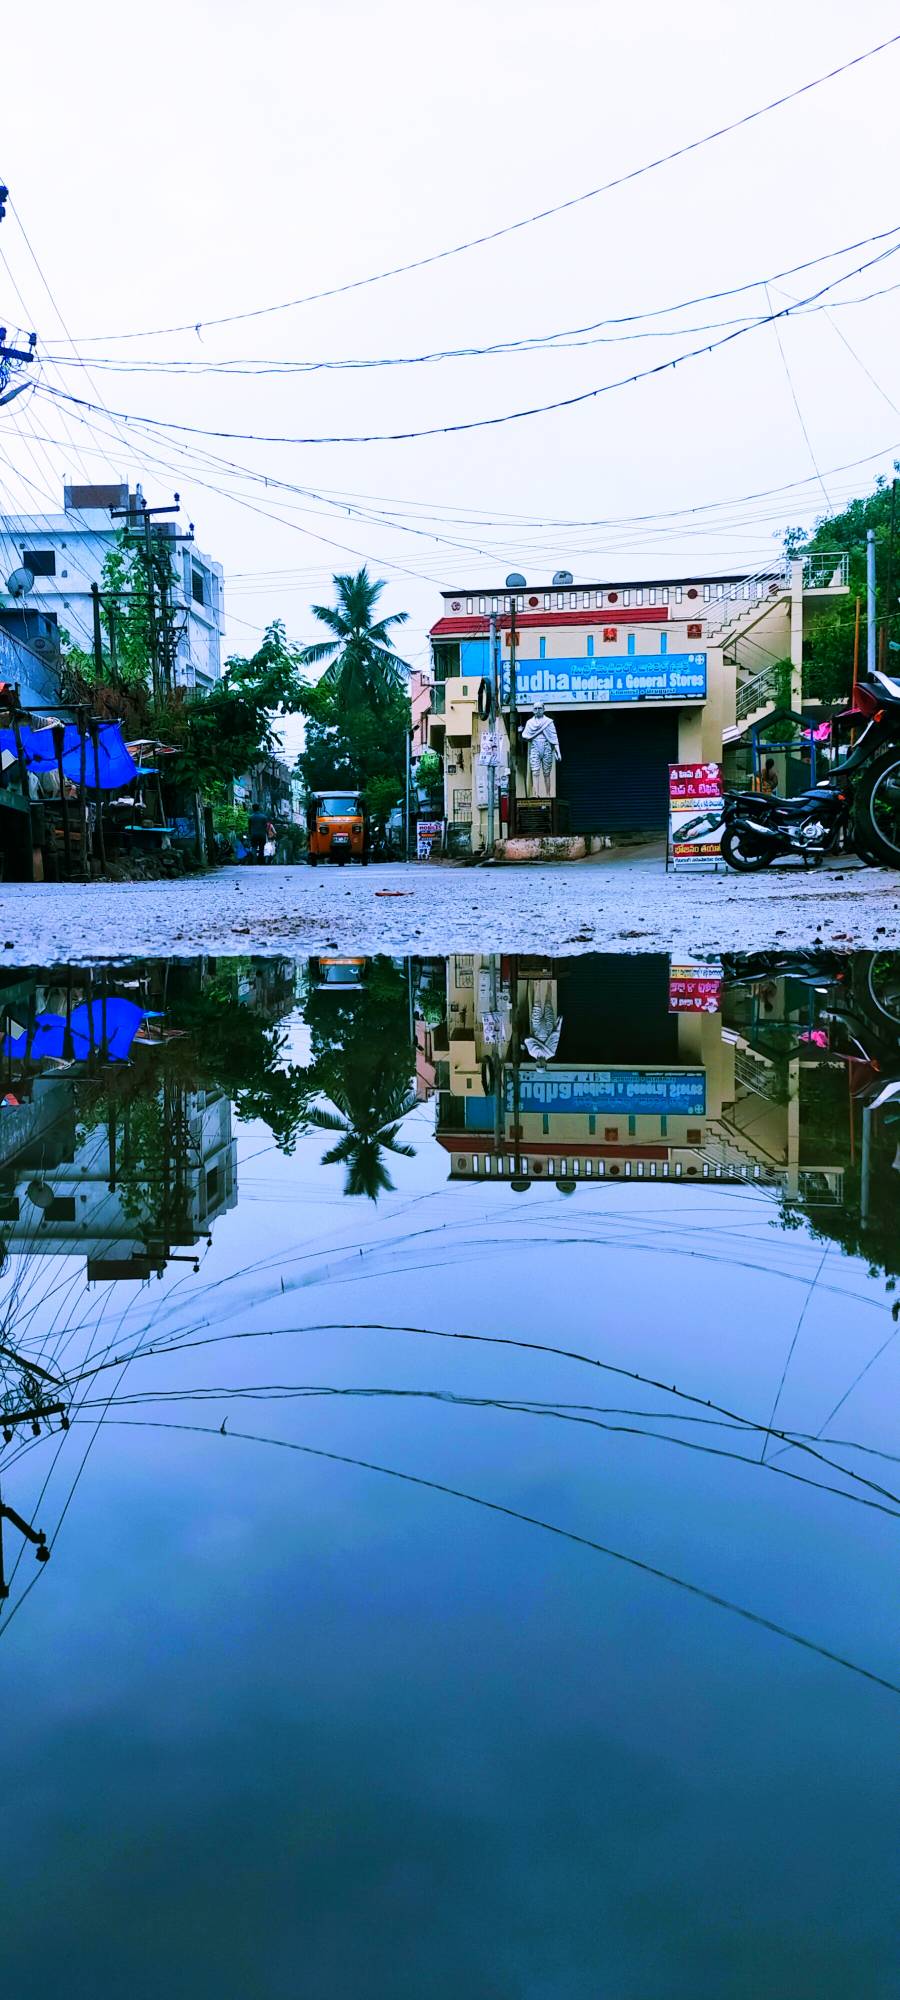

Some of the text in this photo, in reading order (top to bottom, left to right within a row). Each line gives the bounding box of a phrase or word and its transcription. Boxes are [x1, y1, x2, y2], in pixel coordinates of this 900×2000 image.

[571, 675, 613, 690] Medical
[616, 678, 623, 689] &
[625, 673, 667, 688] General
[669, 672, 704, 687] Stores
[687, 784, 697, 794] &
